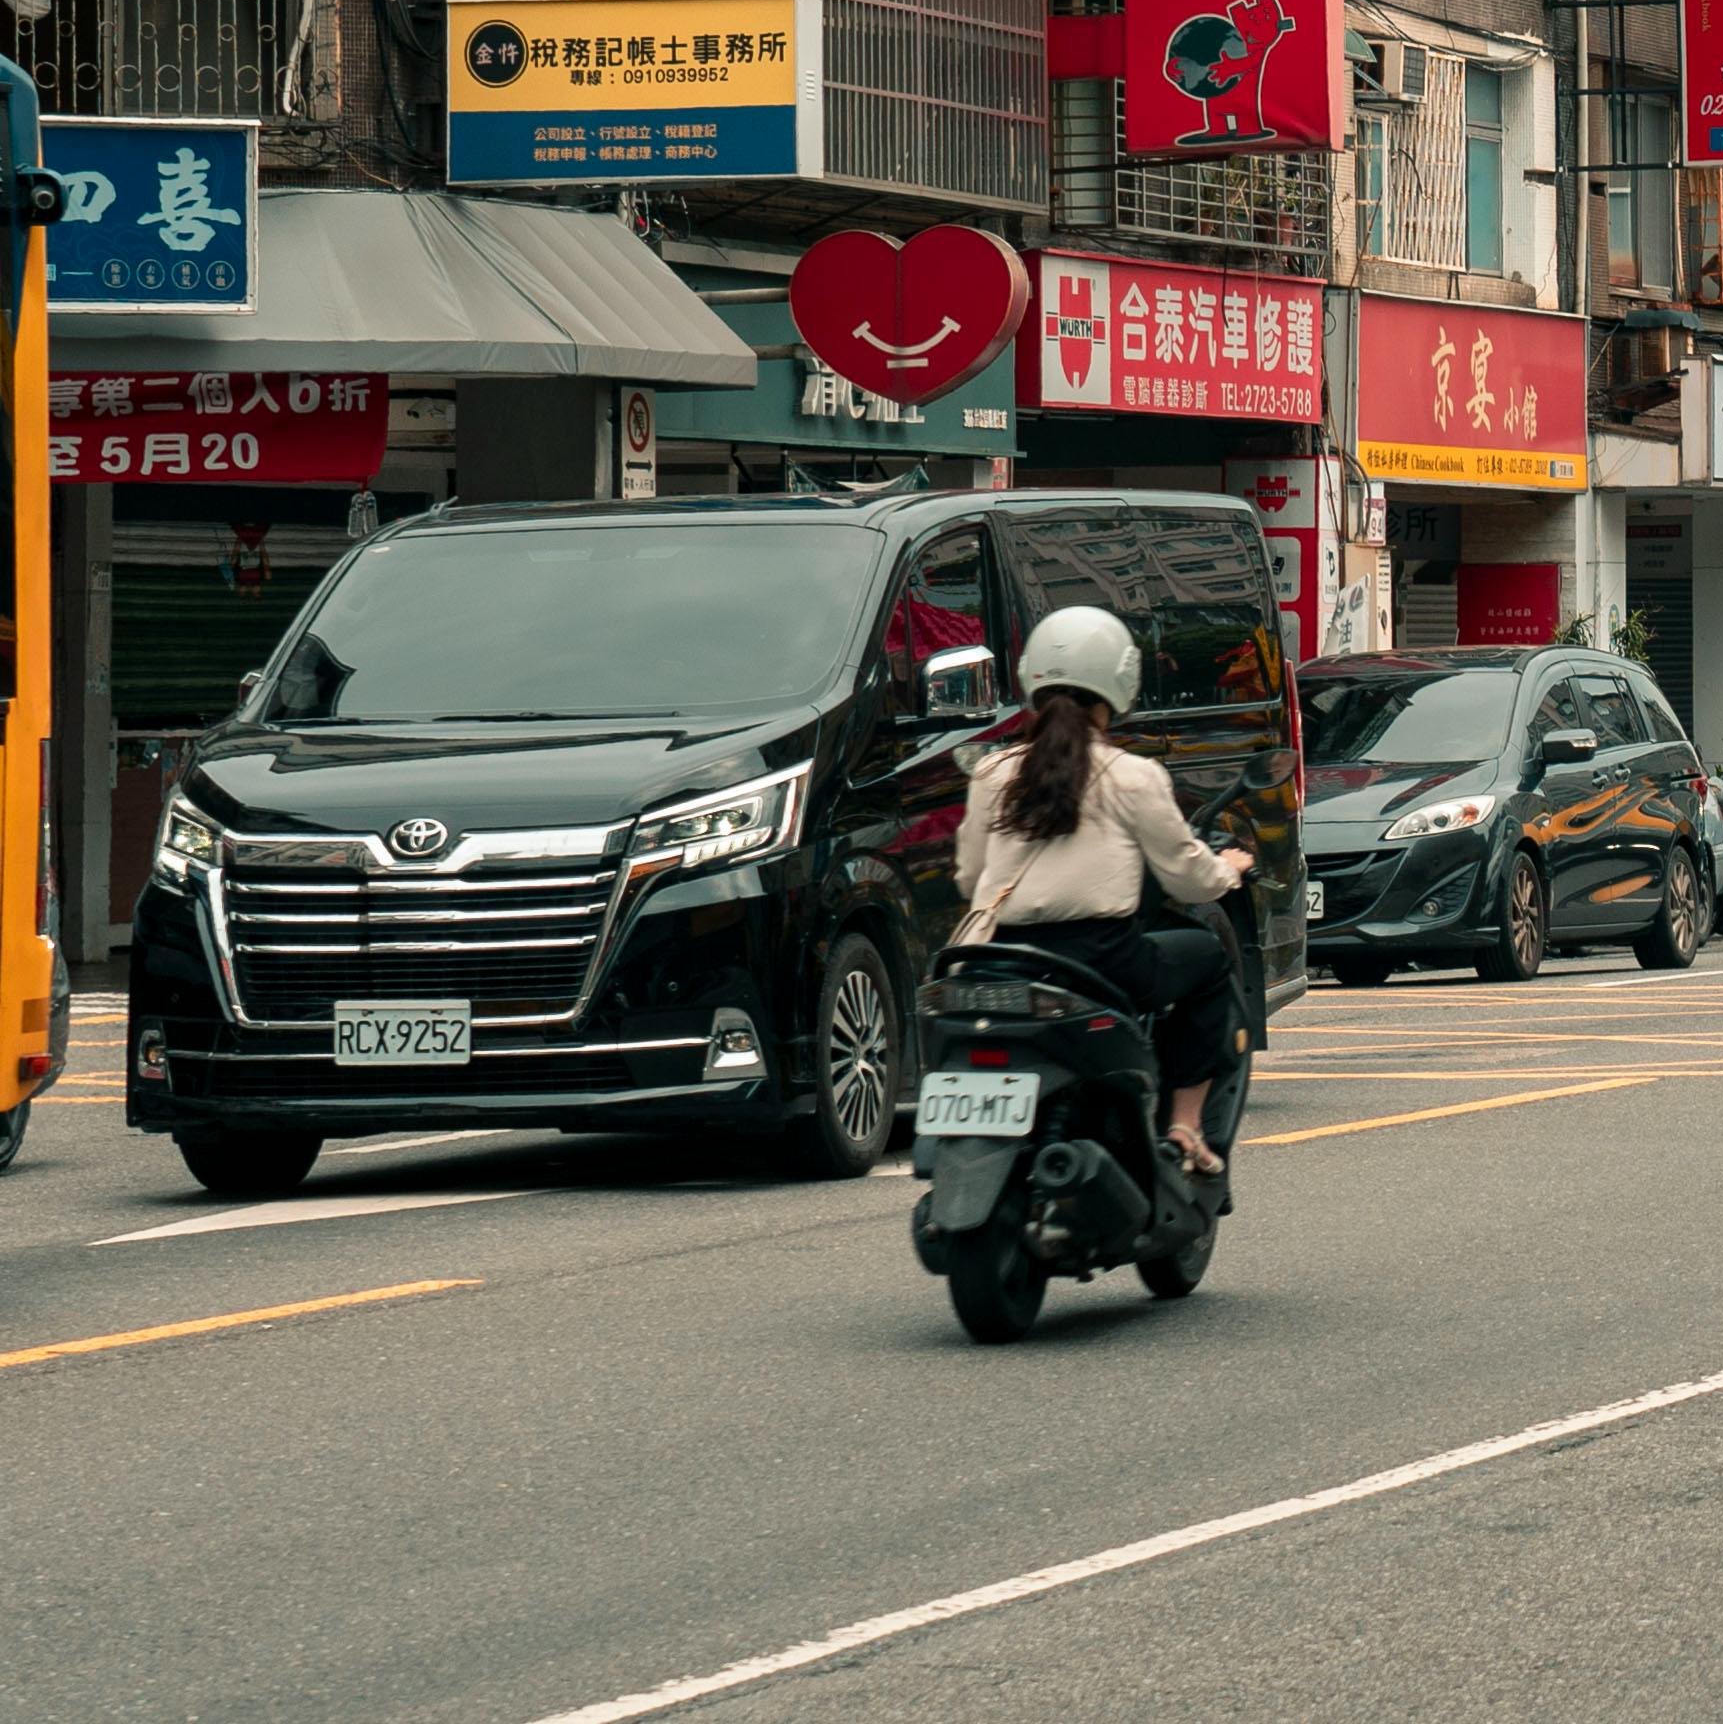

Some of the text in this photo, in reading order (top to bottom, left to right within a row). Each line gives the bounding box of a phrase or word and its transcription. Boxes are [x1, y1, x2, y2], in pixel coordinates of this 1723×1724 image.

[1119, 281, 1314, 376] 合泰汽車修護
[1122, 375, 1208, 410] 電腦儀器診斷
[1220, 382, 1313, 417] TEL:2723-5788
[1430, 325, 1539, 442] 京宴小館
[925, 1094, 1032, 1124] 070-MTJ
